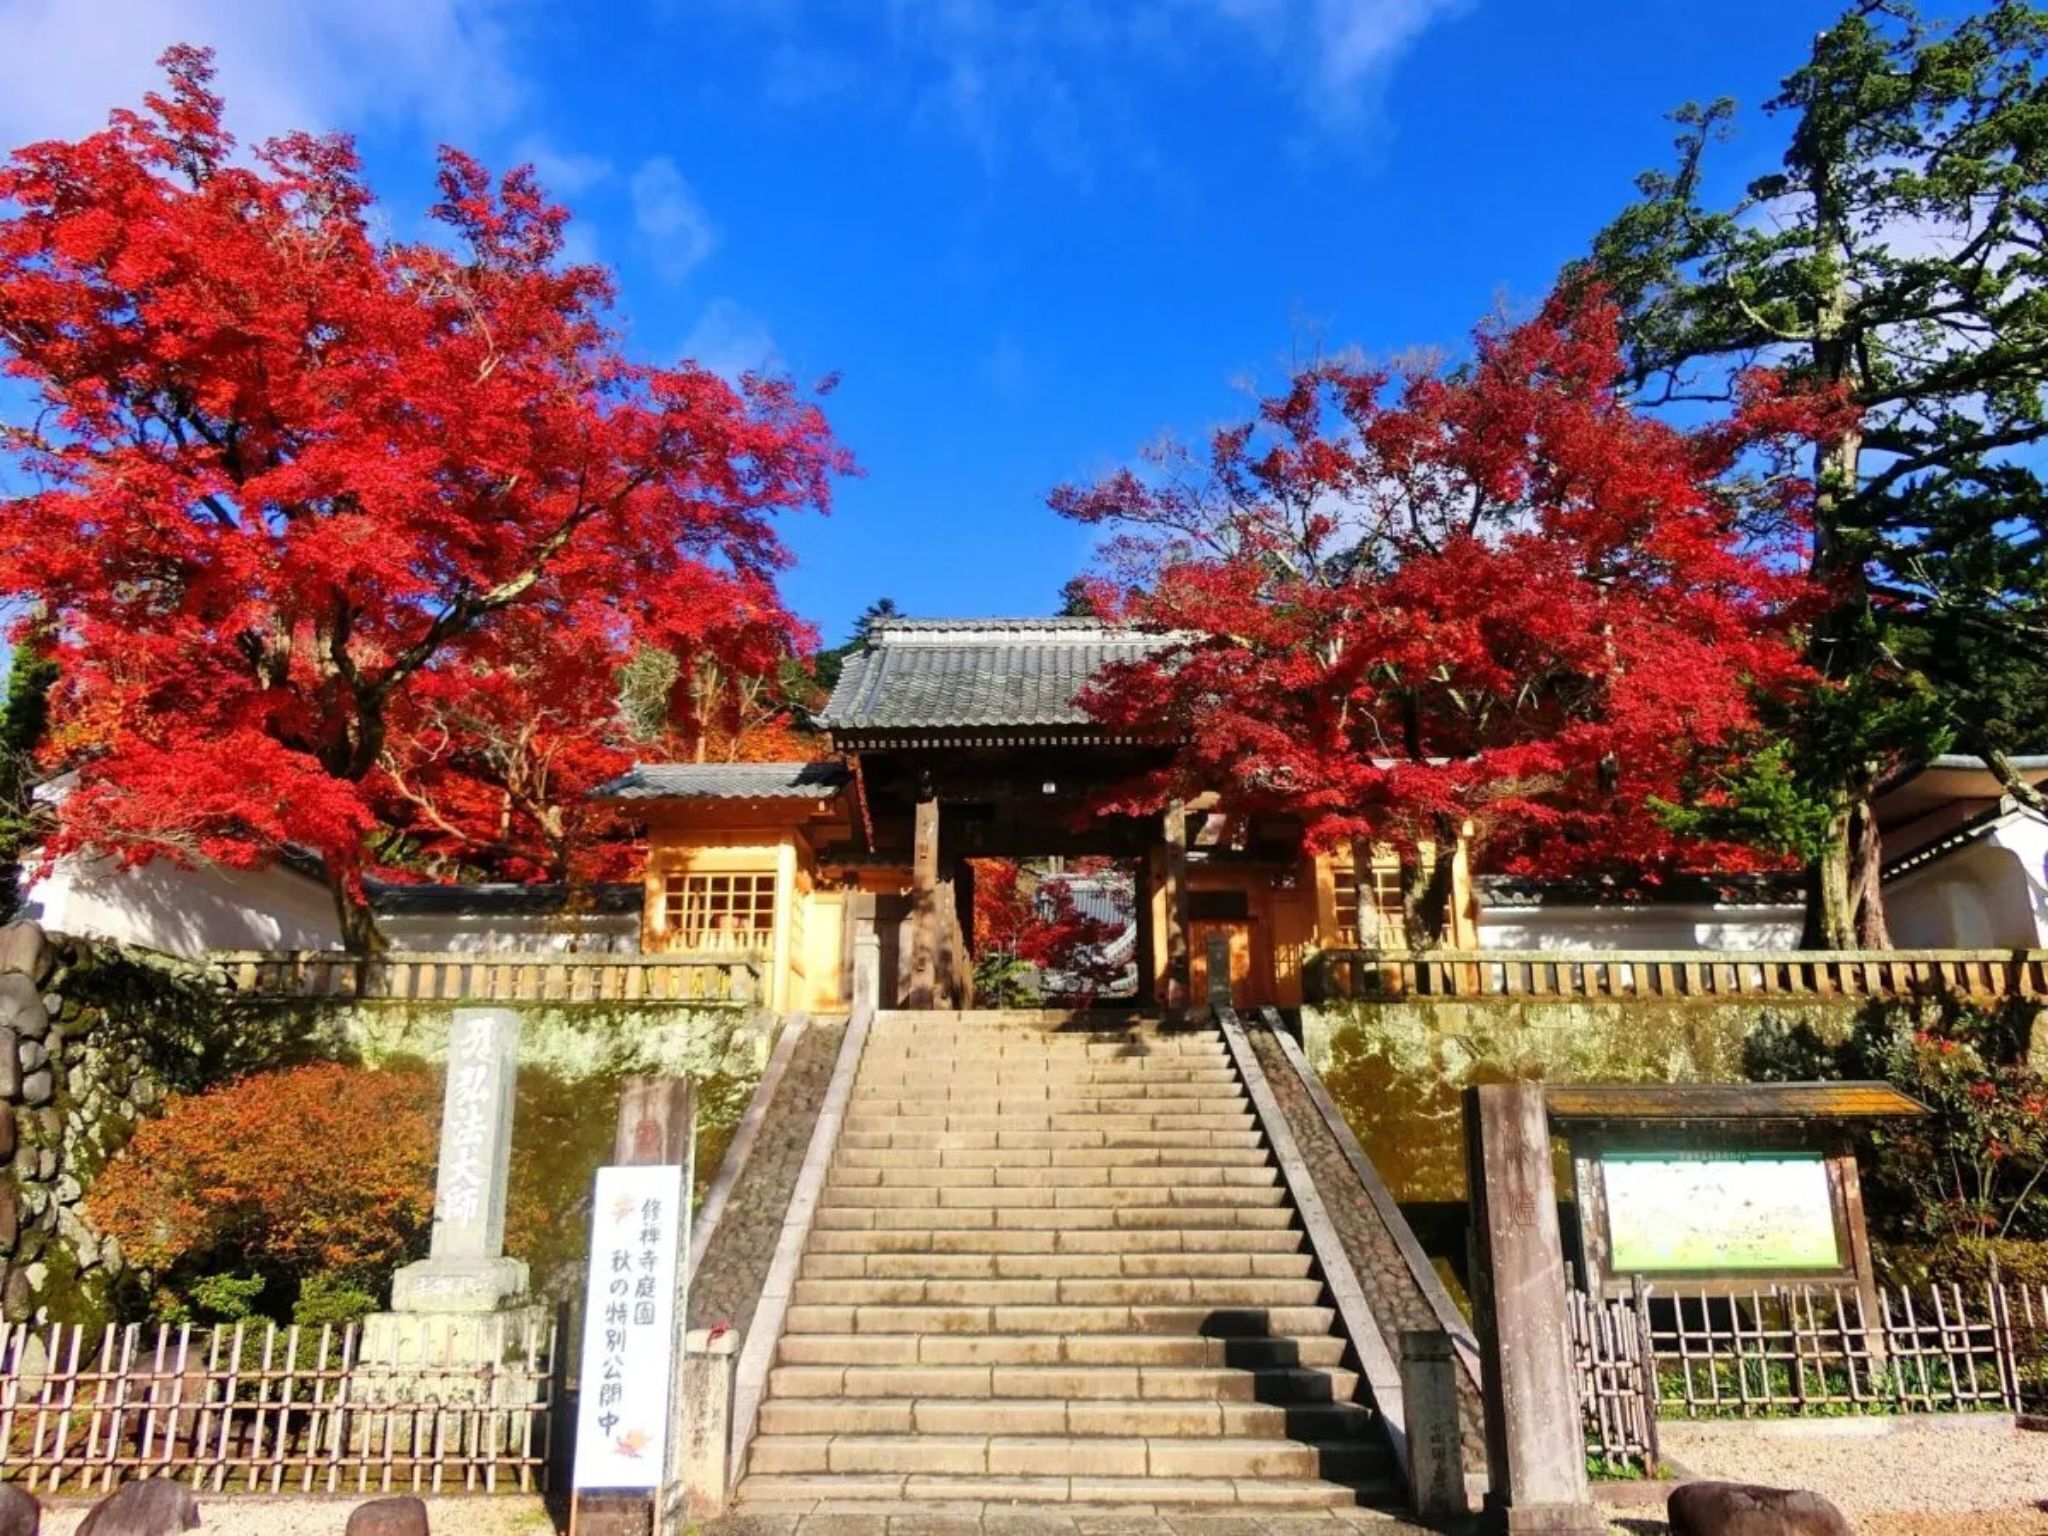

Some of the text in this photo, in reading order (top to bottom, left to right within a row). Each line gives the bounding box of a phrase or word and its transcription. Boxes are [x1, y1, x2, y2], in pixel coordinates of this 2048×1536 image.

[633, 1197, 662, 1325] 修禅寺庭園
[598, 1249, 632, 1437] 秋の特別公開中
